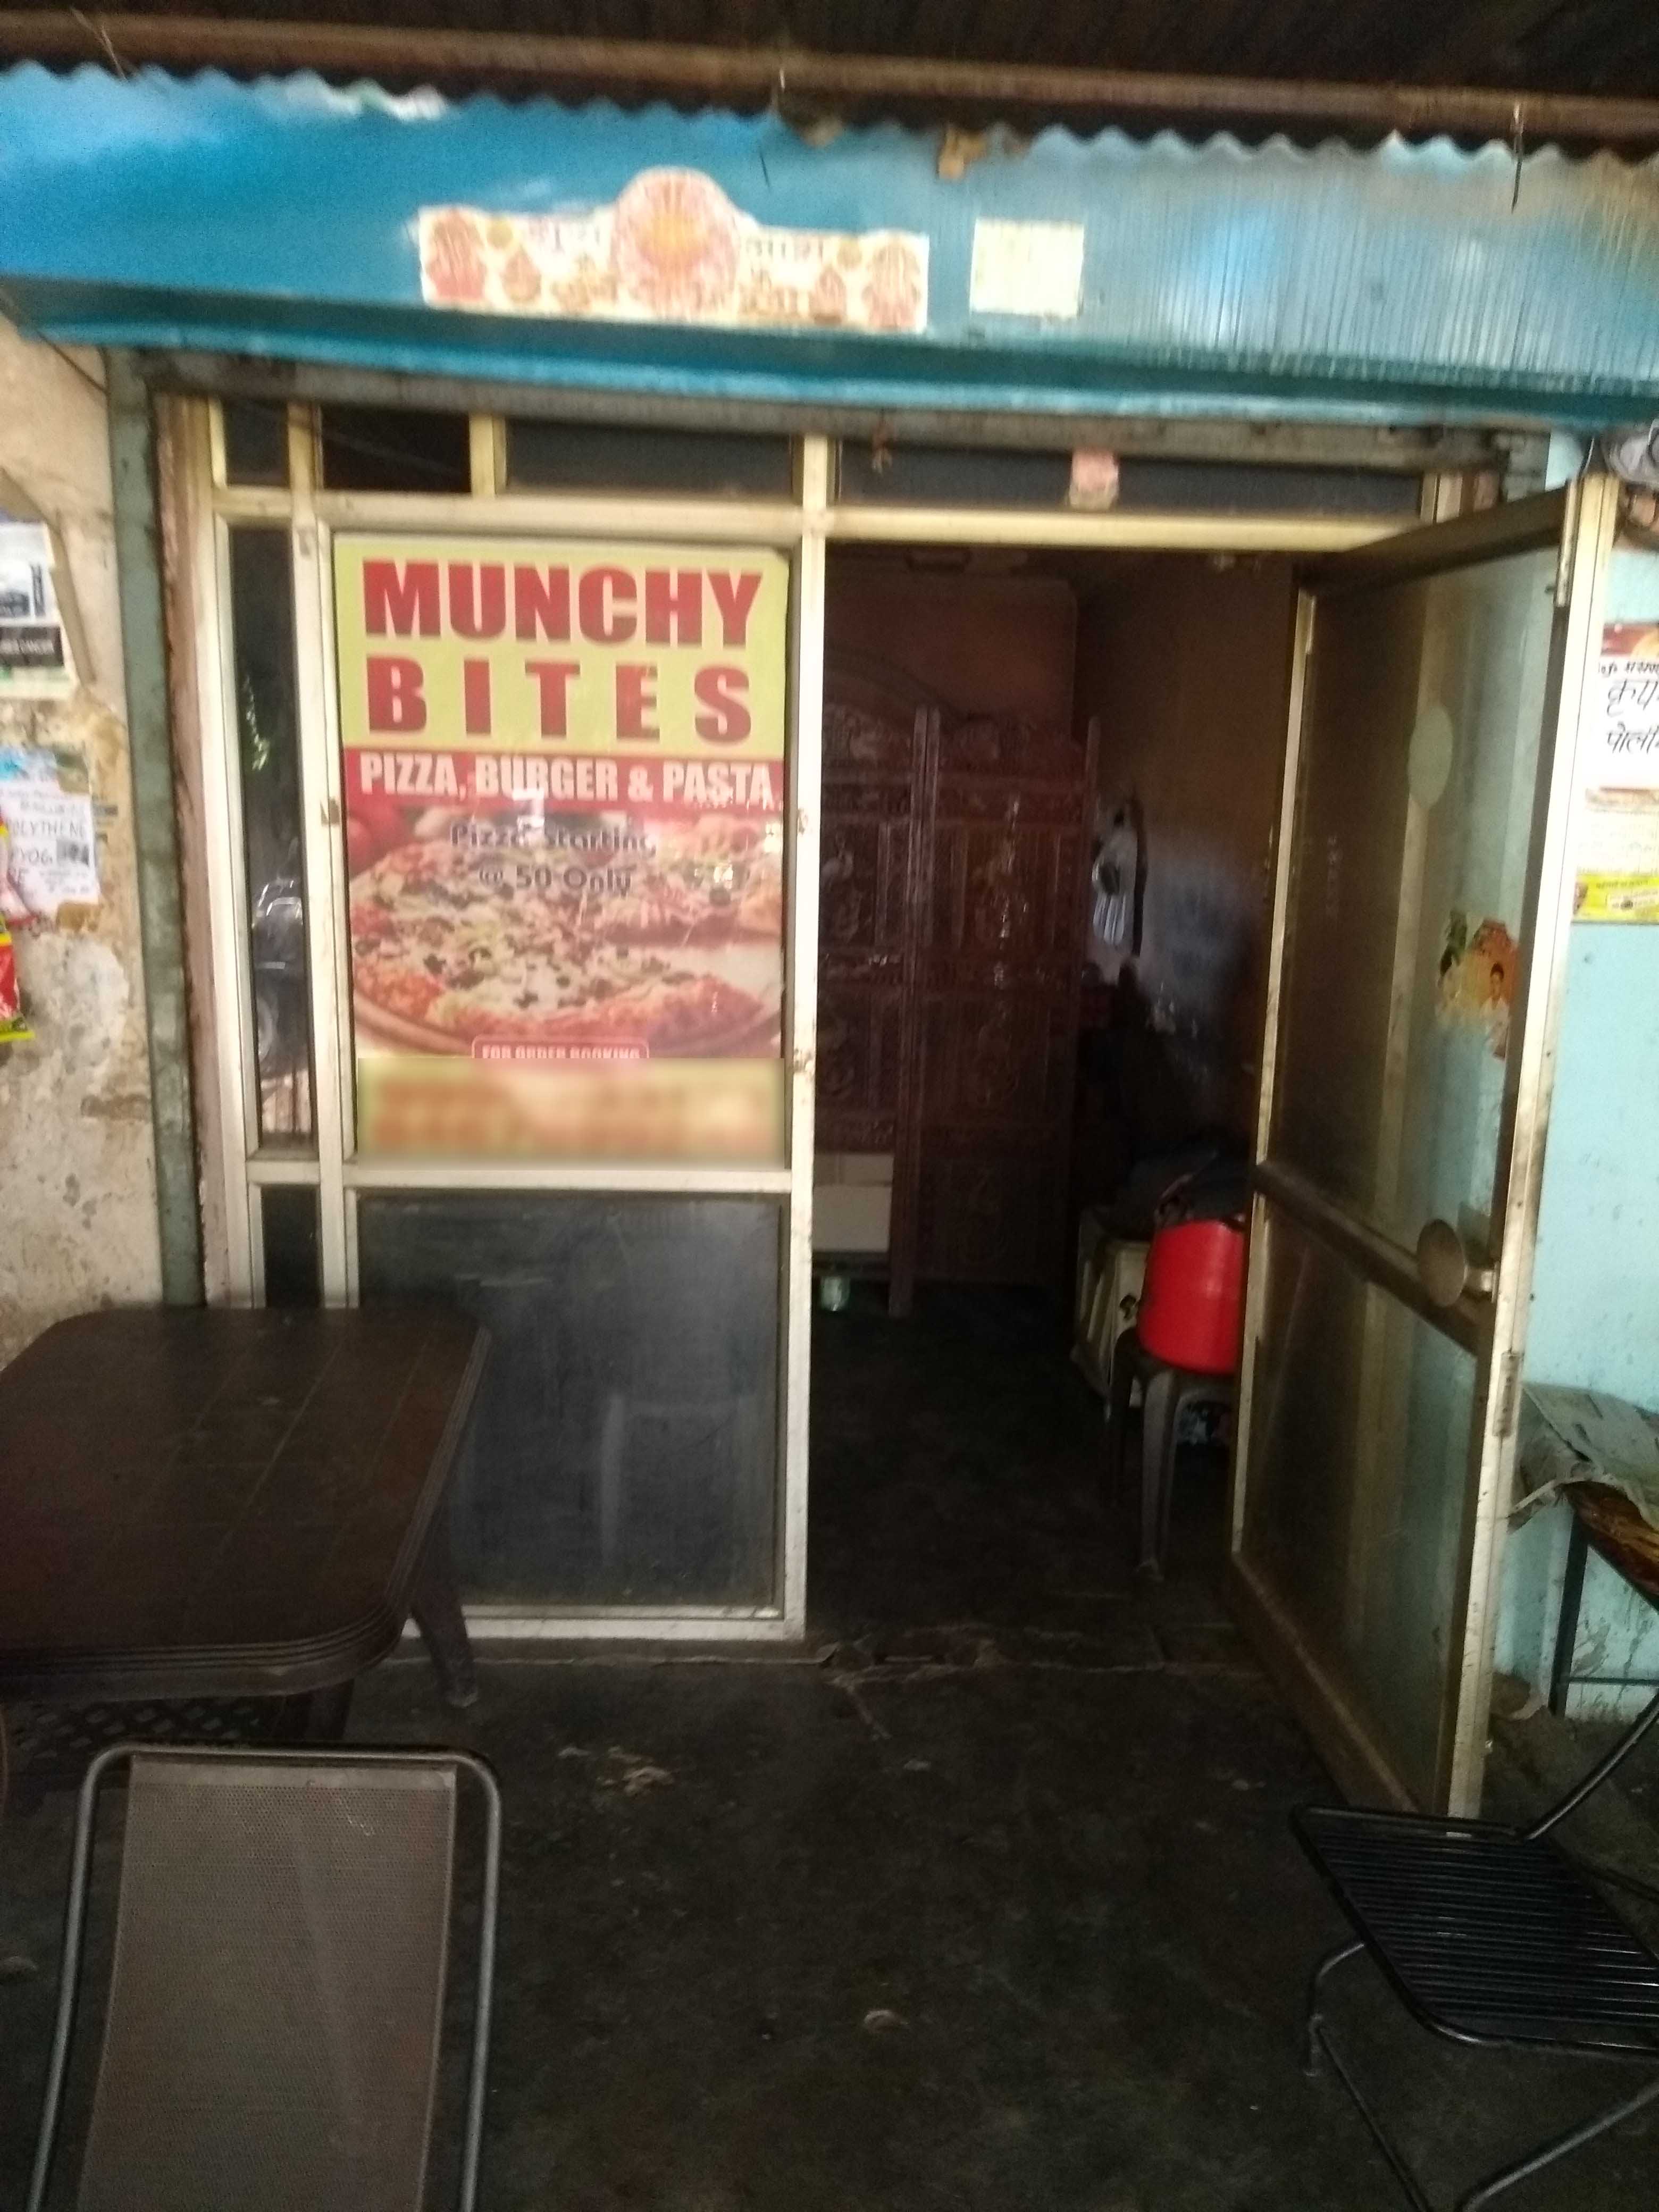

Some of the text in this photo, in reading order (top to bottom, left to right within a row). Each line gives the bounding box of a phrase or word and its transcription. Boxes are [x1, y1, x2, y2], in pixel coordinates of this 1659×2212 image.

[362, 560, 763, 648] MUNCHY
[366, 656, 752, 744] BITES
[359, 751, 774, 808] PIZZA, BURGER & PASTA
[451, 823, 656, 859] Pizza Starting
[479, 866, 632, 895] @ 50 Only
